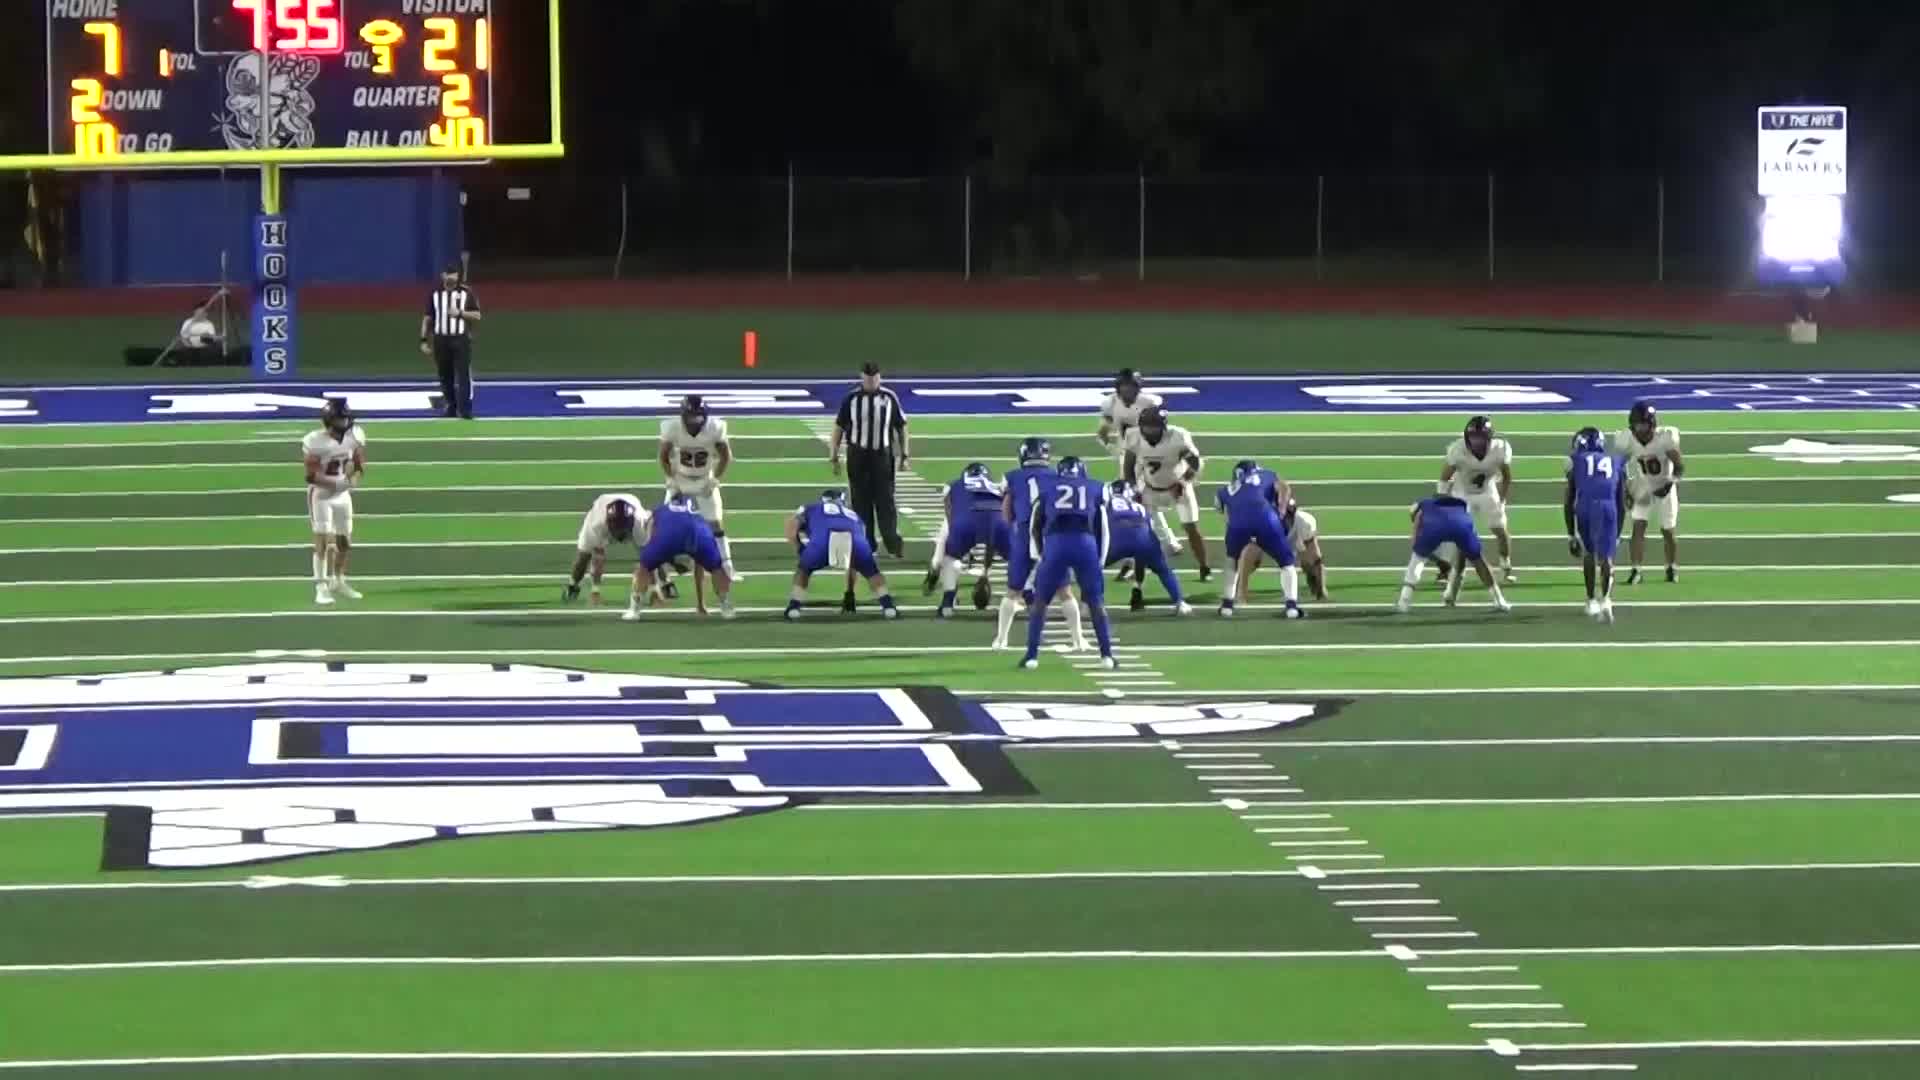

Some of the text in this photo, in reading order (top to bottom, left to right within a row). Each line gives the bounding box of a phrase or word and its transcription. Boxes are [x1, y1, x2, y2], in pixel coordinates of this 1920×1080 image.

[53, 0, 118, 18] HOME
[84, 22, 120, 76] 7
[423, 17, 488, 71] 21
[170, 53, 197, 71] TOL
[344, 51, 371, 69] TOL
[371, 45, 392, 73] 3
[71, 78, 103, 123] 2
[101, 89, 163, 111] DOWN
[353, 86, 441, 108] QUARTER
[442, 73, 471, 118] 2
[75, 123, 118, 159] 10
[116, 133, 174, 153] TO GO
[345, 130, 429, 148] BALL ON
[261, 221, 288, 374] HOOKS
[1585, 454, 1613, 479] 14
[1637, 457, 1662, 475] 10
[1054, 484, 1088, 510] 21
